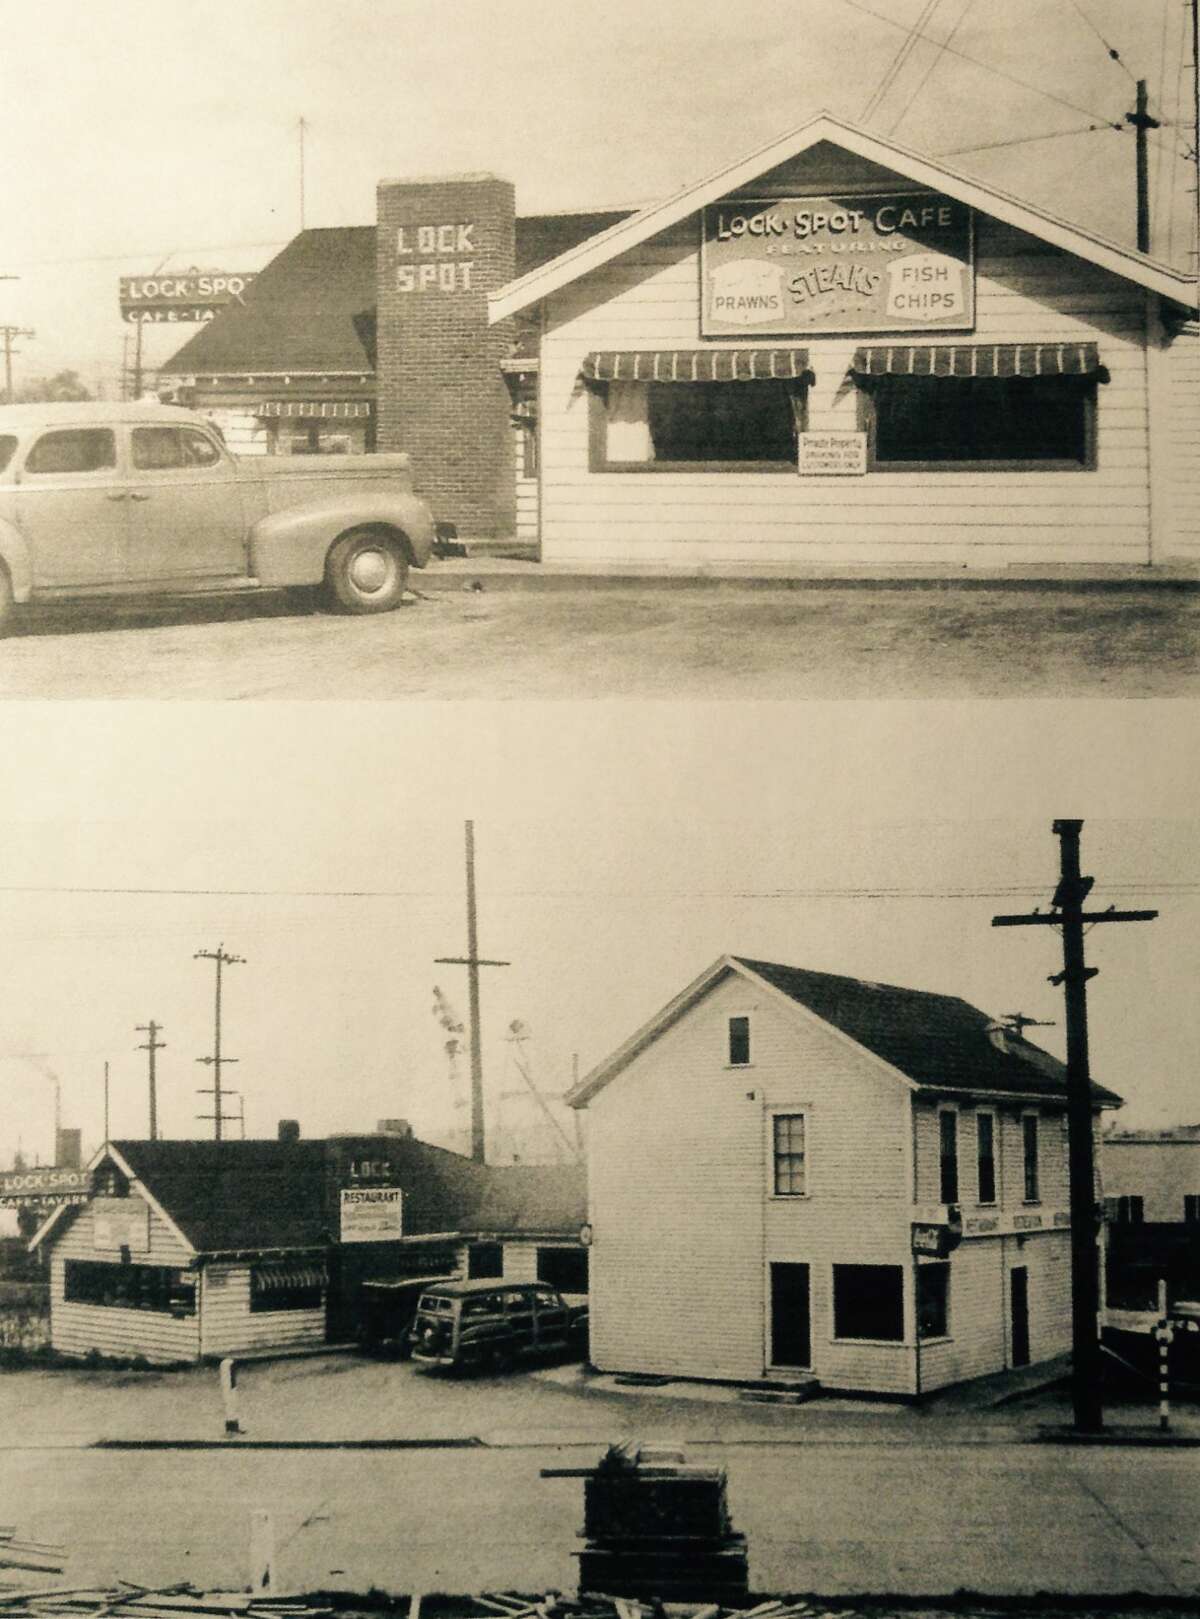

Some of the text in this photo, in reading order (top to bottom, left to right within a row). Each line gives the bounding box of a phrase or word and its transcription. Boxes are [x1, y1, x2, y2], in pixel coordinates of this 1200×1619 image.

[793, 210, 864, 239] SPOT
[876, 205, 952, 233] CAFE
[396, 224, 475, 255] LOCK
[766, 240, 908, 257] FEATURING
[396, 261, 475, 292] SPOT
[901, 266, 949, 283] FISH
[197, 276, 253, 296] SPO
[787, 263, 881, 305] STEAKS
[714, 294, 779, 310] PRAWNS
[893, 292, 956, 309] CHIPS
[48, 1172, 89, 1188] SPOT
[343, 1191, 399, 1204] RESTAURANT
